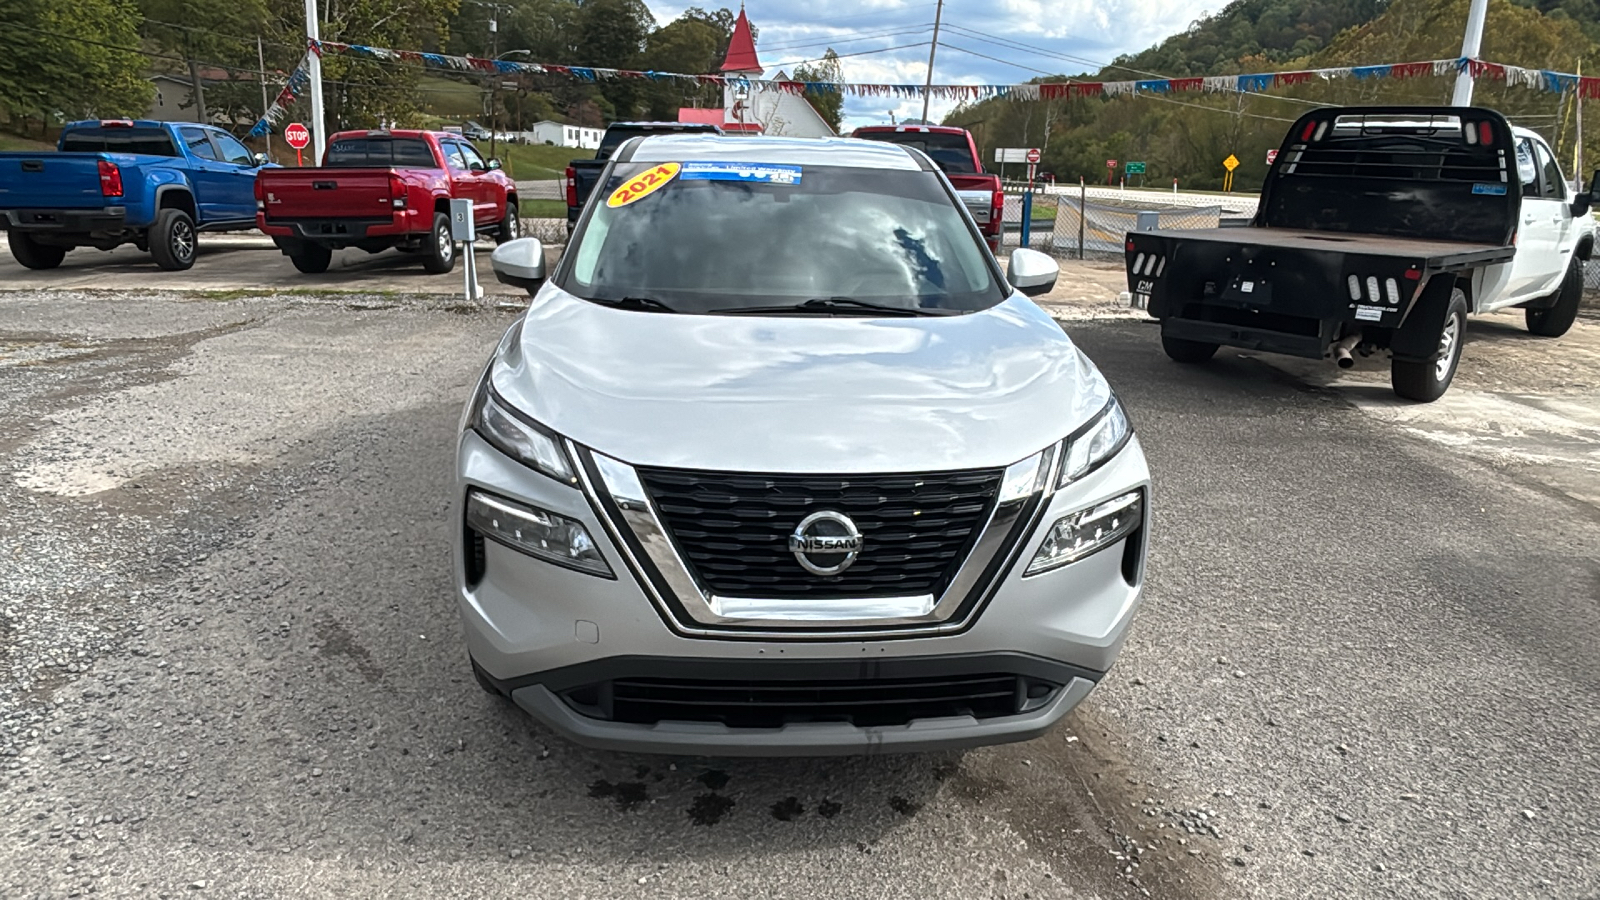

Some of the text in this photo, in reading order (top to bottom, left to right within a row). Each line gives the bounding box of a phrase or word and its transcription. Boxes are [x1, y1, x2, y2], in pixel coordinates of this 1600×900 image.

[287, 131, 307, 141] STOP
[757, 166, 796, 174] Warranty
[616, 166, 673, 203] 2021
[1138, 279, 1154, 291] CM
[797, 539, 856, 550] NISSAN
